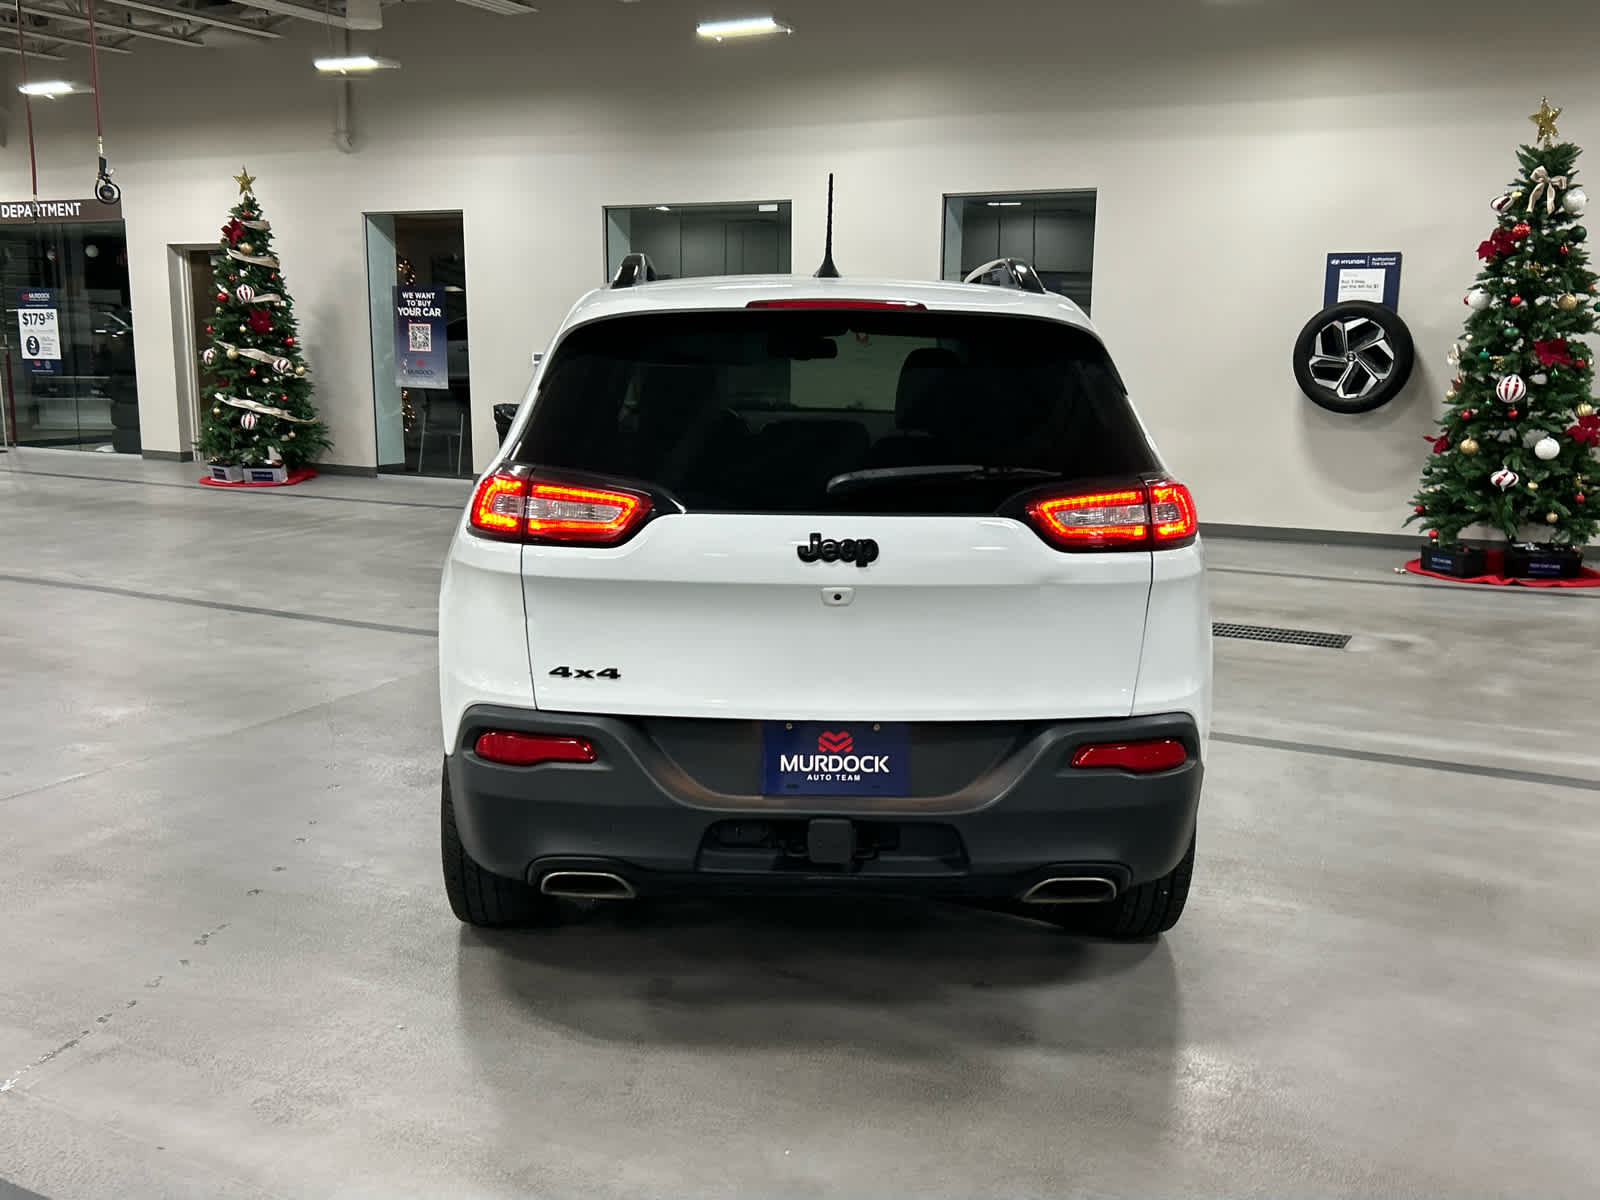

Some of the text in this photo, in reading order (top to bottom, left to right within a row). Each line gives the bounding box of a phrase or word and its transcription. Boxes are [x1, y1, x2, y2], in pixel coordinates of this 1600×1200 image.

[1, 202, 81, 218] DEPARTMENT
[398, 307, 441, 317] YOUR CAR
[797, 533, 879, 567] Jeep
[549, 666, 621, 680] 4x4
[780, 754, 889, 773] MURDOCK
